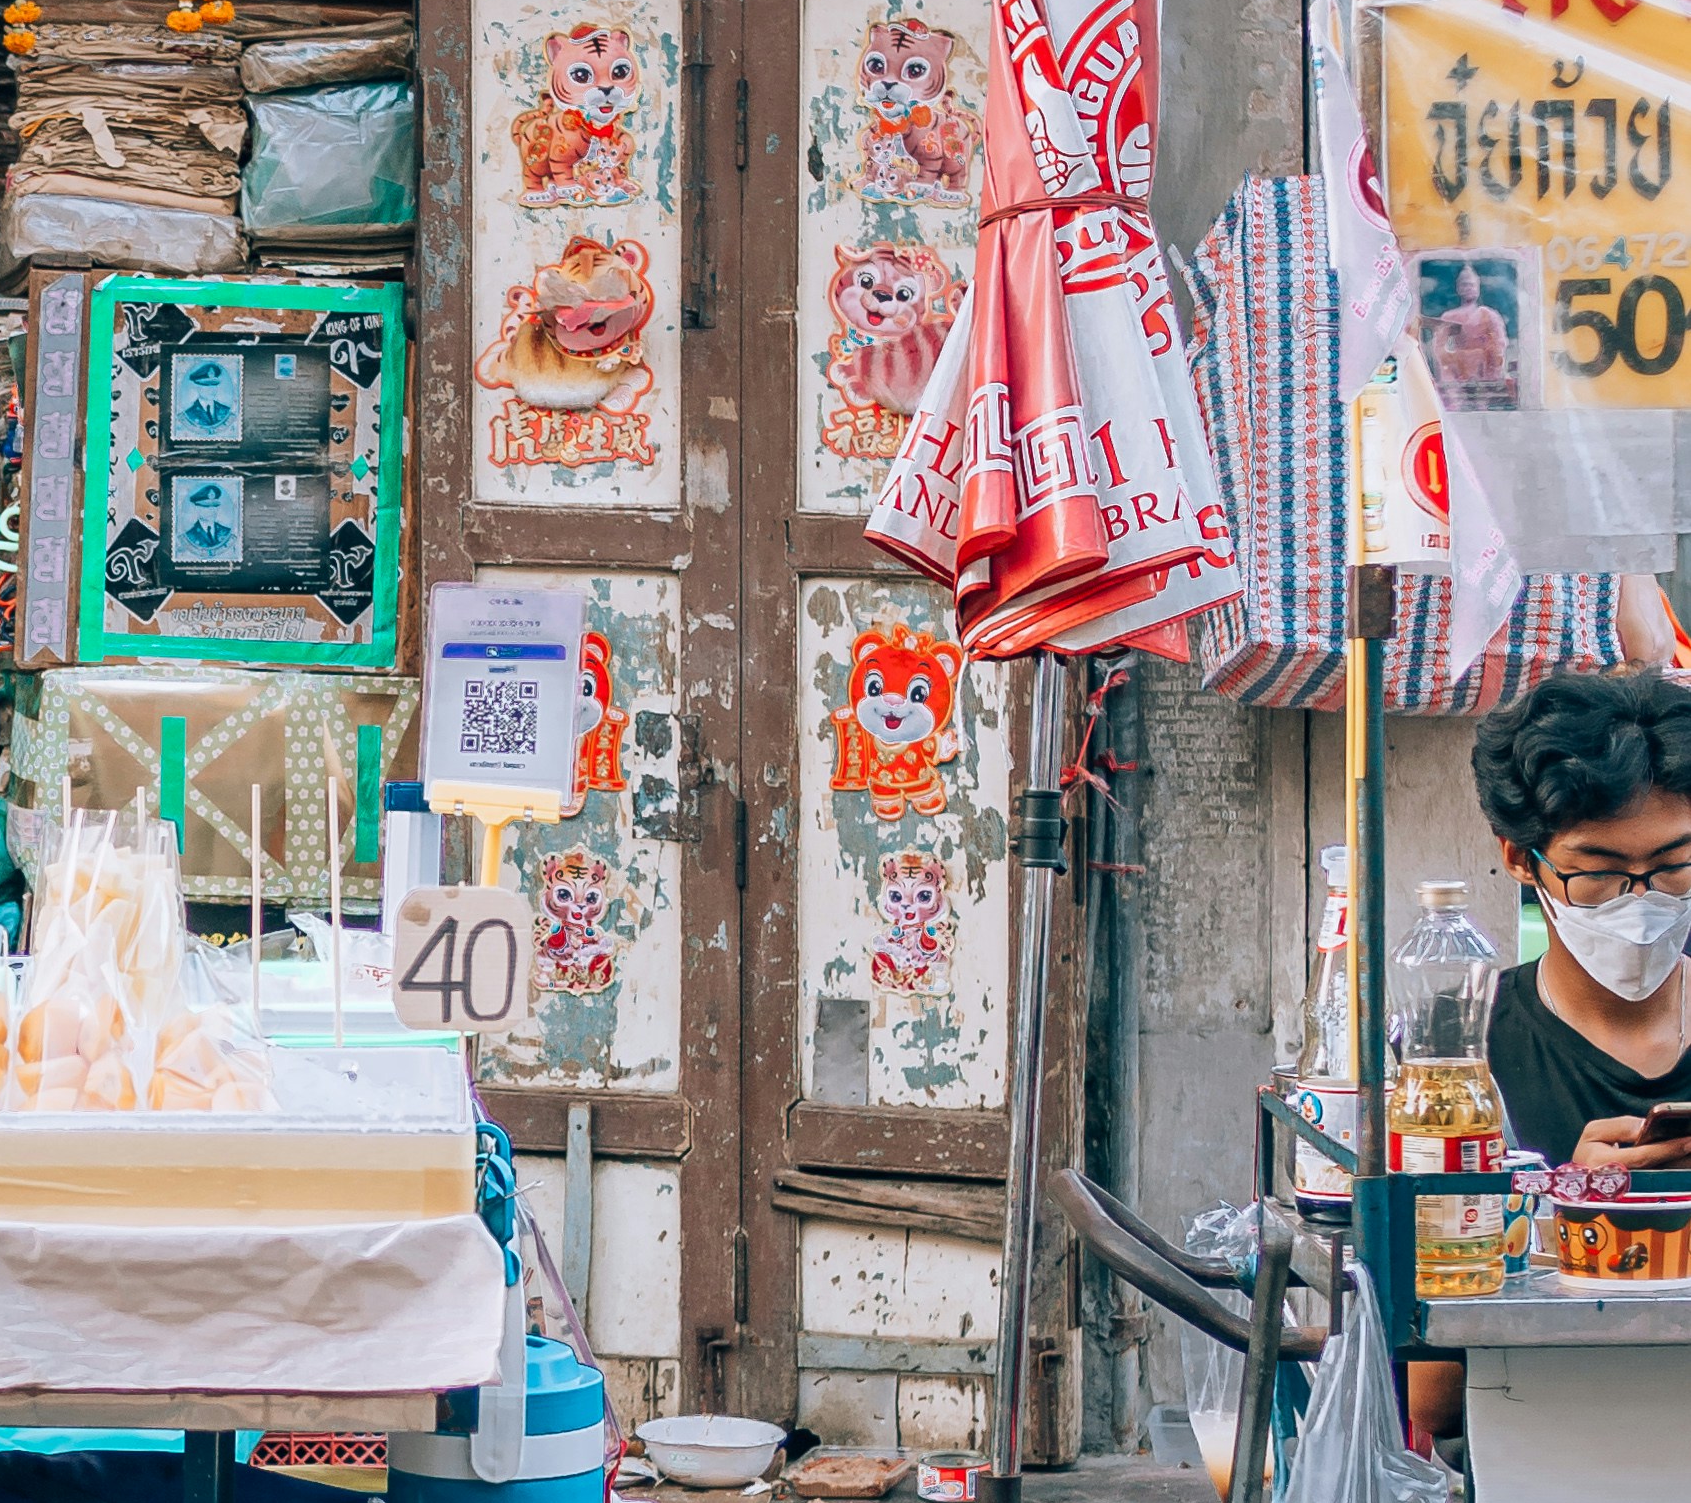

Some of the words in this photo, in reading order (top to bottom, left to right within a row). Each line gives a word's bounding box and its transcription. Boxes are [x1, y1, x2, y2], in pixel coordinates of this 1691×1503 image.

[325, 319, 348, 336] KING
[349, 316, 361, 332] OF
[398, 914, 517, 1024] 40
